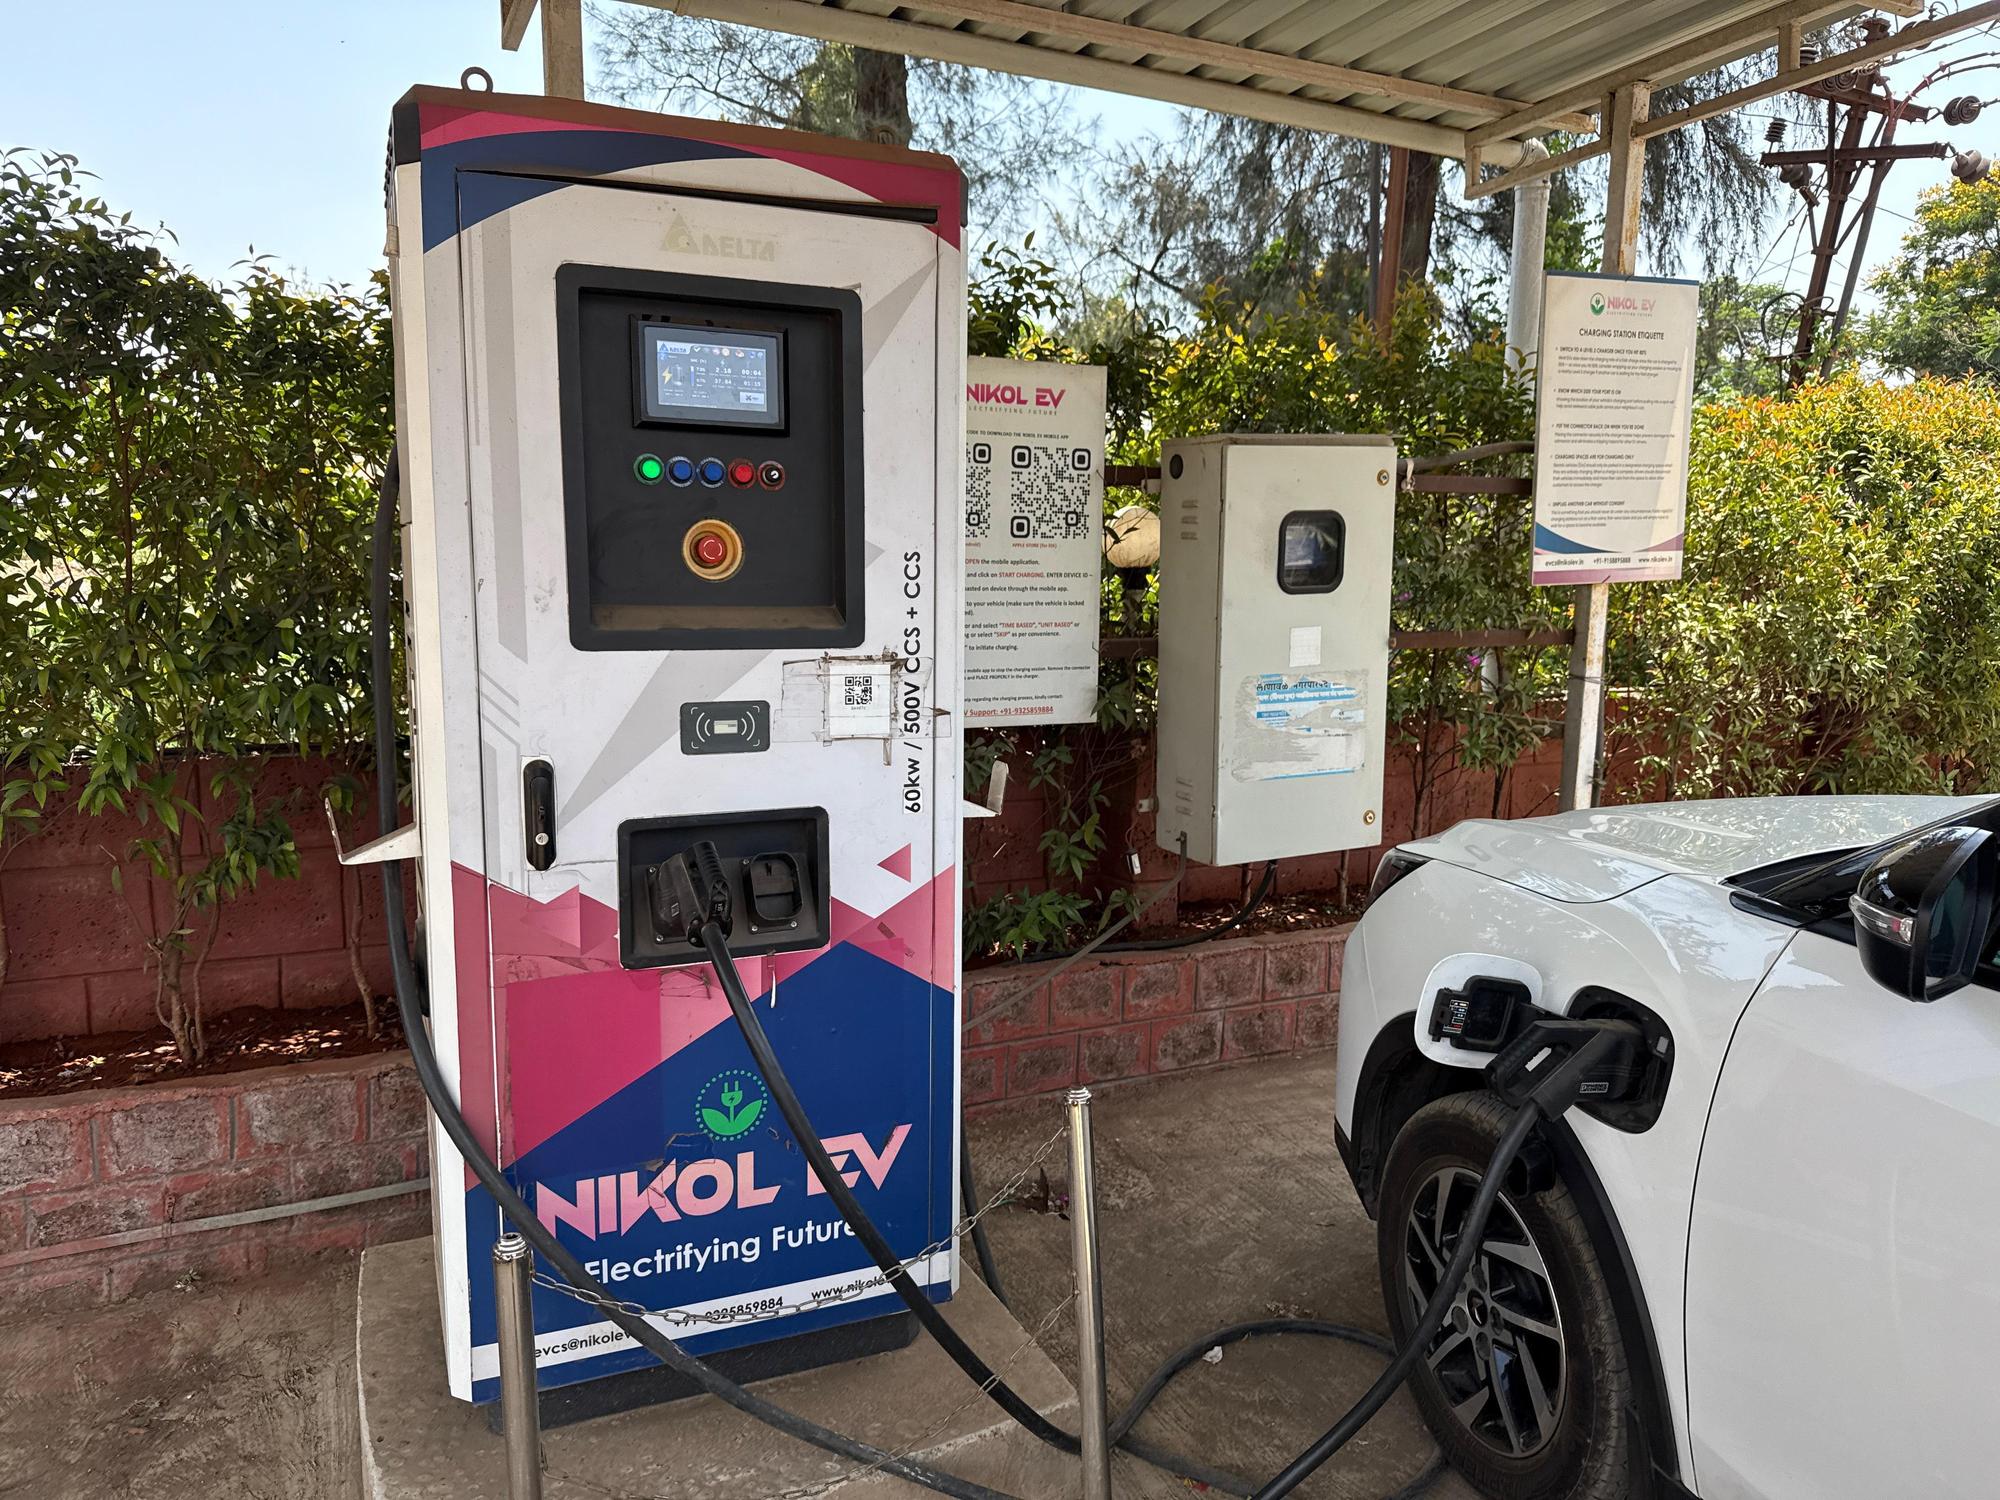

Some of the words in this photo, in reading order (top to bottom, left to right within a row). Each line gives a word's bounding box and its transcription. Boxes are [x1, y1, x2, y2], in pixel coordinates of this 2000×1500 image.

[1607, 296, 1637, 310] NIKOL
[1641, 299, 1656, 311] EV
[1579, 328, 1612, 338] CHARGING
[1613, 330, 1636, 339] STATION
[1638, 331, 1664, 340] ETIQUETTE
[967, 384, 1028, 405] NIKOL
[1036, 388, 1066, 409] EV
[966, 405, 1023, 414] LECTRIFYING
[1010, 559, 1040, 567] application.
[904, 551, 920, 599] CCS
[906, 606, 918, 619] +
[904, 626, 920, 674] CCS
[904, 682, 920, 734] 500V
[970, 709, 998, 717] Support:
[1000, 706, 1053, 715] +91-9325859884
[536, 1151, 781, 1241] NIKOL
[807, 1123, 912, 1196] EV
